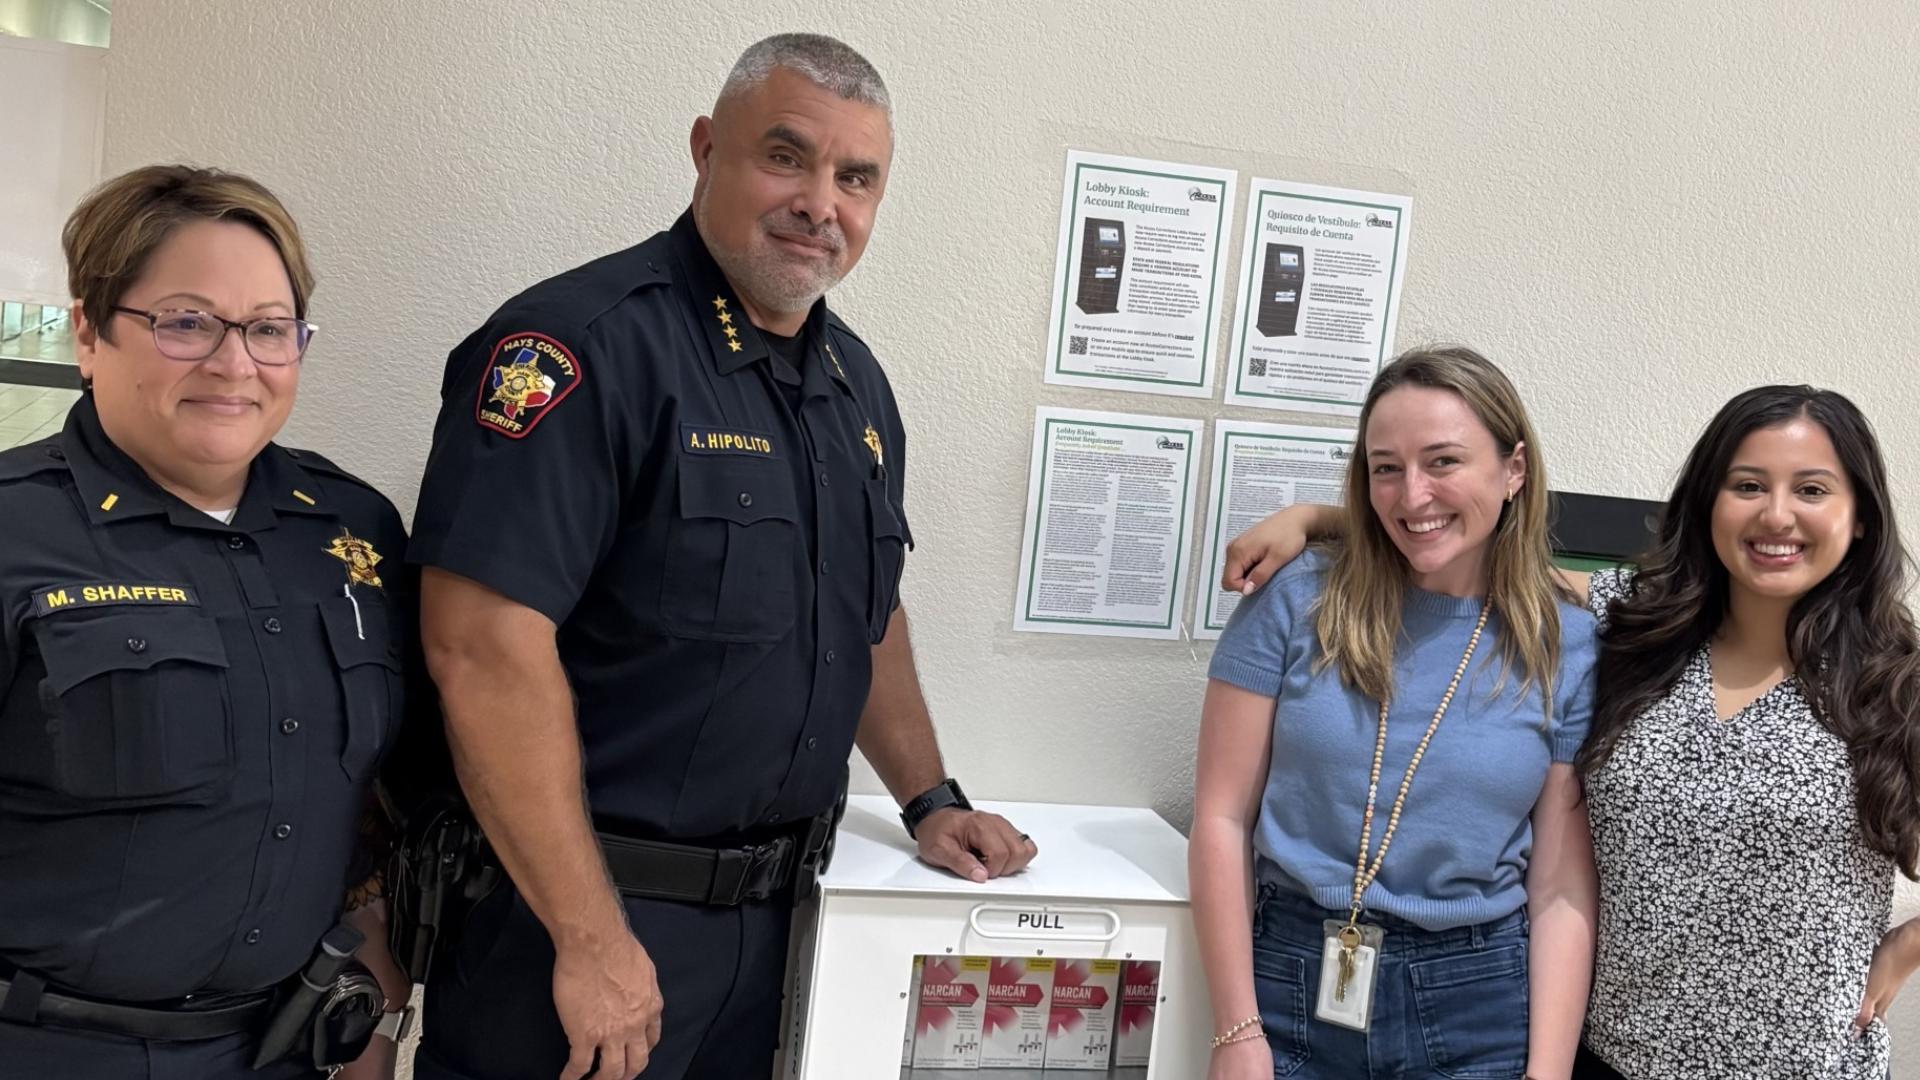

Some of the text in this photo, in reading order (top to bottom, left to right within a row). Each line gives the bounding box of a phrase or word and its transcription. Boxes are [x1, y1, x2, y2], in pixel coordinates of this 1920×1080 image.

[1086, 181, 1150, 198] Lobby Kiosk:
[1084, 196, 1190, 216] Account Requirement
[1268, 210, 1360, 228] Quiosco de Vestíbulo:
[1266, 222, 1354, 240] Requisito de Cuenta
[504, 339, 534, 352] HAYS
[536, 342, 574, 376] COUNTY
[480, 409, 522, 432] SHERIFF
[691, 432, 770, 452] A. HIPOLITO
[46, 585, 188, 608] M. SHAFFER
[1018, 914, 1064, 928] PULL
[923, 984, 962, 997] NARCAN
[988, 984, 1026, 998] NARCAN
[1053, 986, 1092, 999] NARCAN
